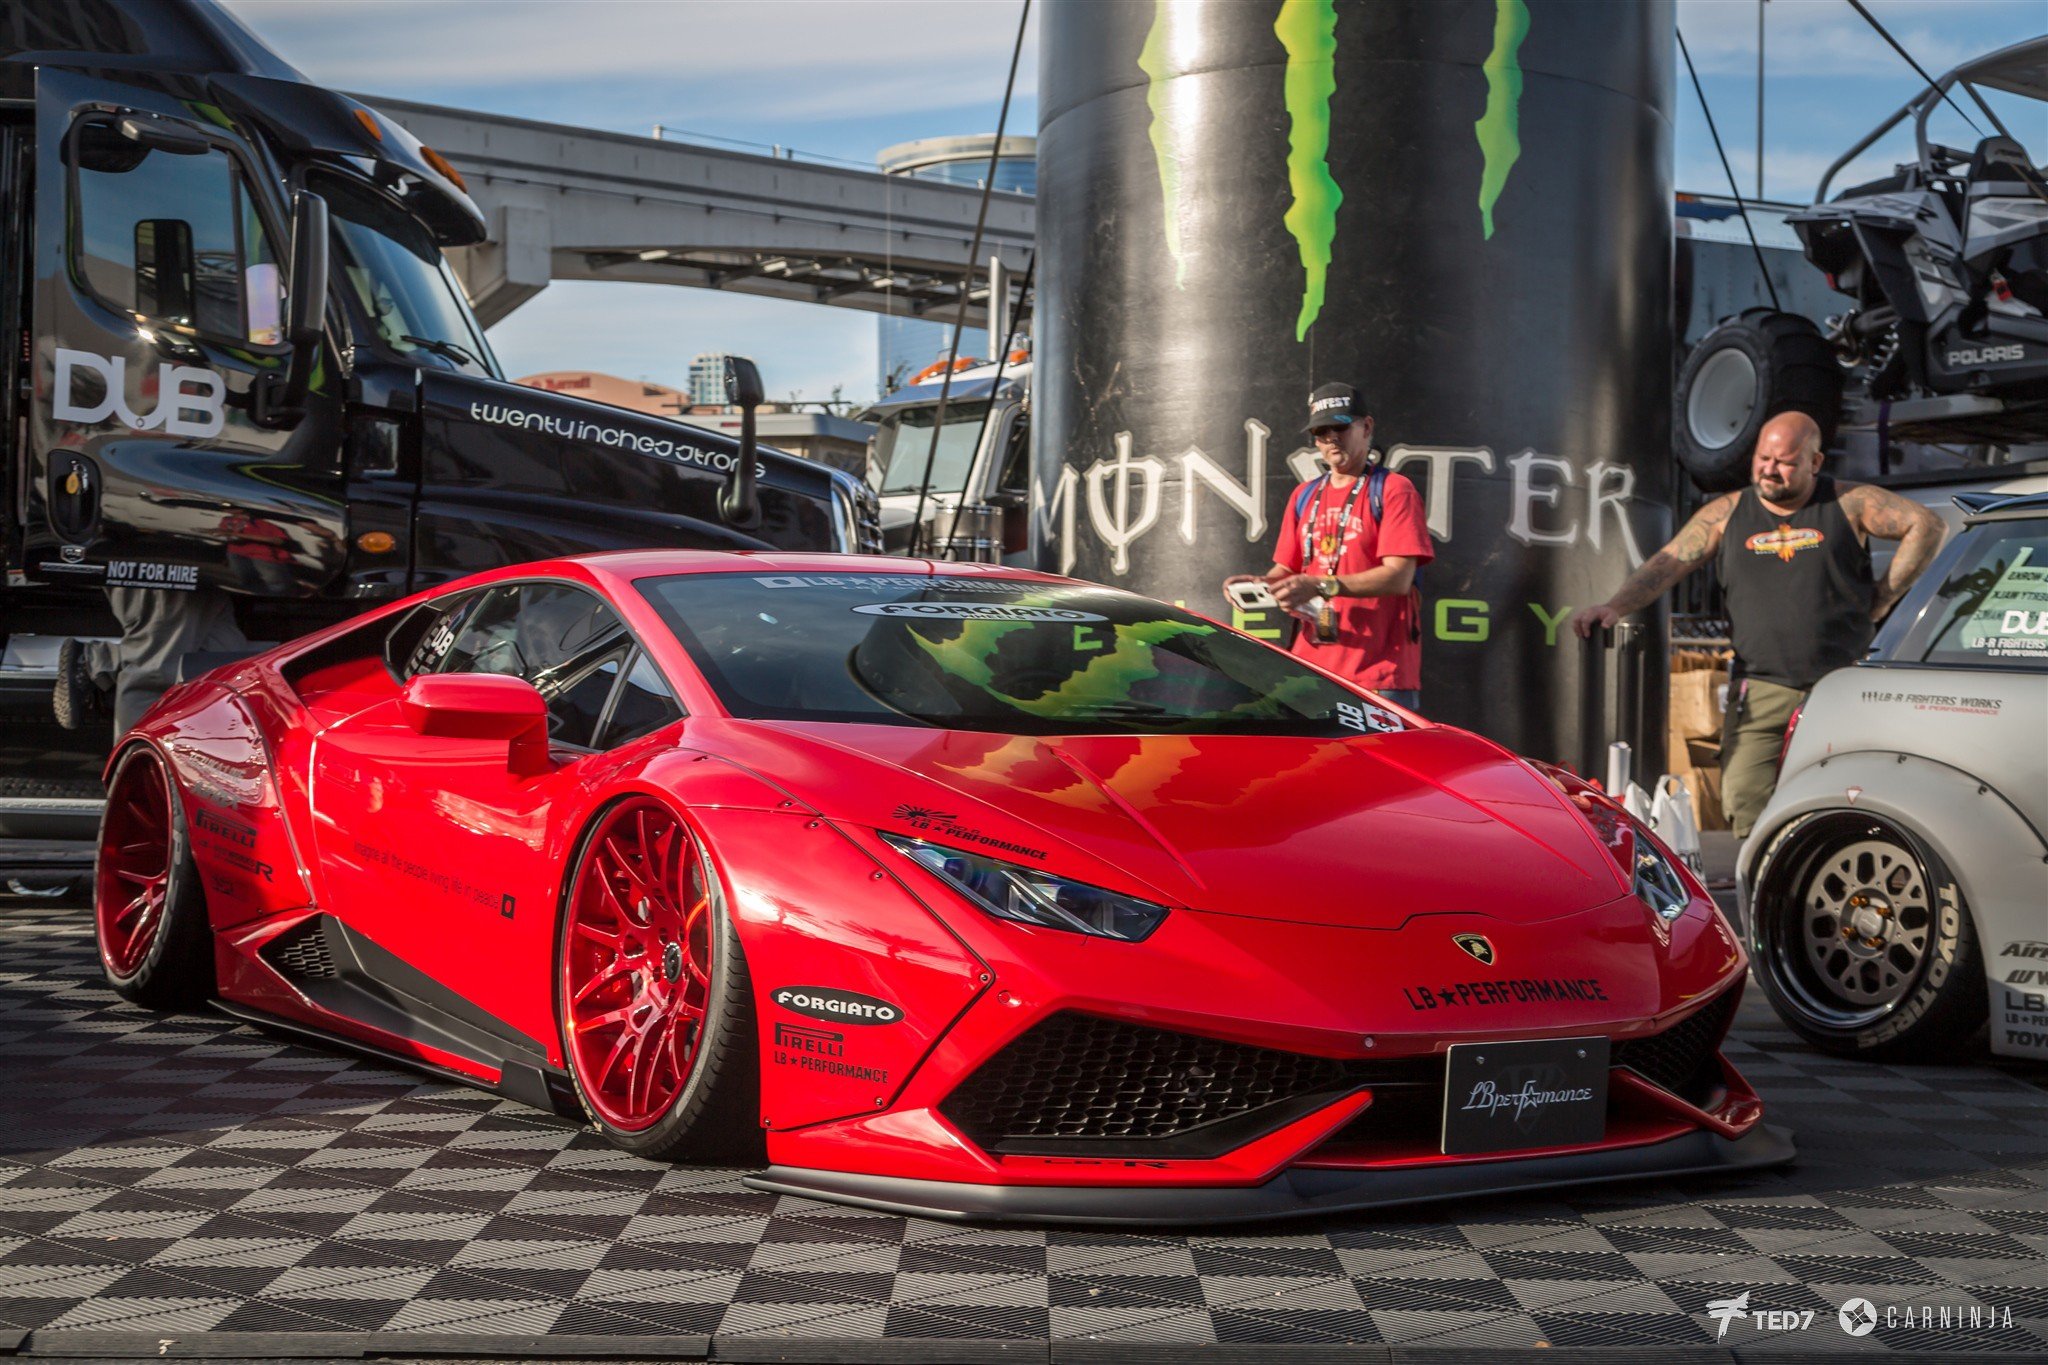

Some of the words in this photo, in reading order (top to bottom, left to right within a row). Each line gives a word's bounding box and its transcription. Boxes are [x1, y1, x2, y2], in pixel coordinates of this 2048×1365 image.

[1947, 344, 2025, 366] POLARIS
[53, 347, 227, 439] DUB
[1033, 419, 1646, 577] MONTER
[107, 560, 136, 579] NOT
[137, 562, 165, 581] FOR
[167, 564, 199, 583] HIRE
[801, 576, 845, 586] LB
[880, 604, 1086, 619] FORGIATO
[1905, 694, 1957, 706] FIGHTERS
[1960, 697, 2002, 709] WORKS
[196, 807, 257, 848] PIRELLI
[910, 820, 929, 830] LB
[945, 828, 1049, 861] PERFORMANCE
[1928, 882, 1960, 989] TOYO
[777, 991, 896, 1020] FORGIATO
[1402, 985, 1438, 1011] LB
[1455, 978, 1610, 1006] PERFORMANCE
[774, 1022, 844, 1057] PIRELLI
[2005, 1029, 2048, 1047] TOY
[774, 1050, 787, 1065] LB
[801, 1056, 888, 1084] PERFORMANCE
